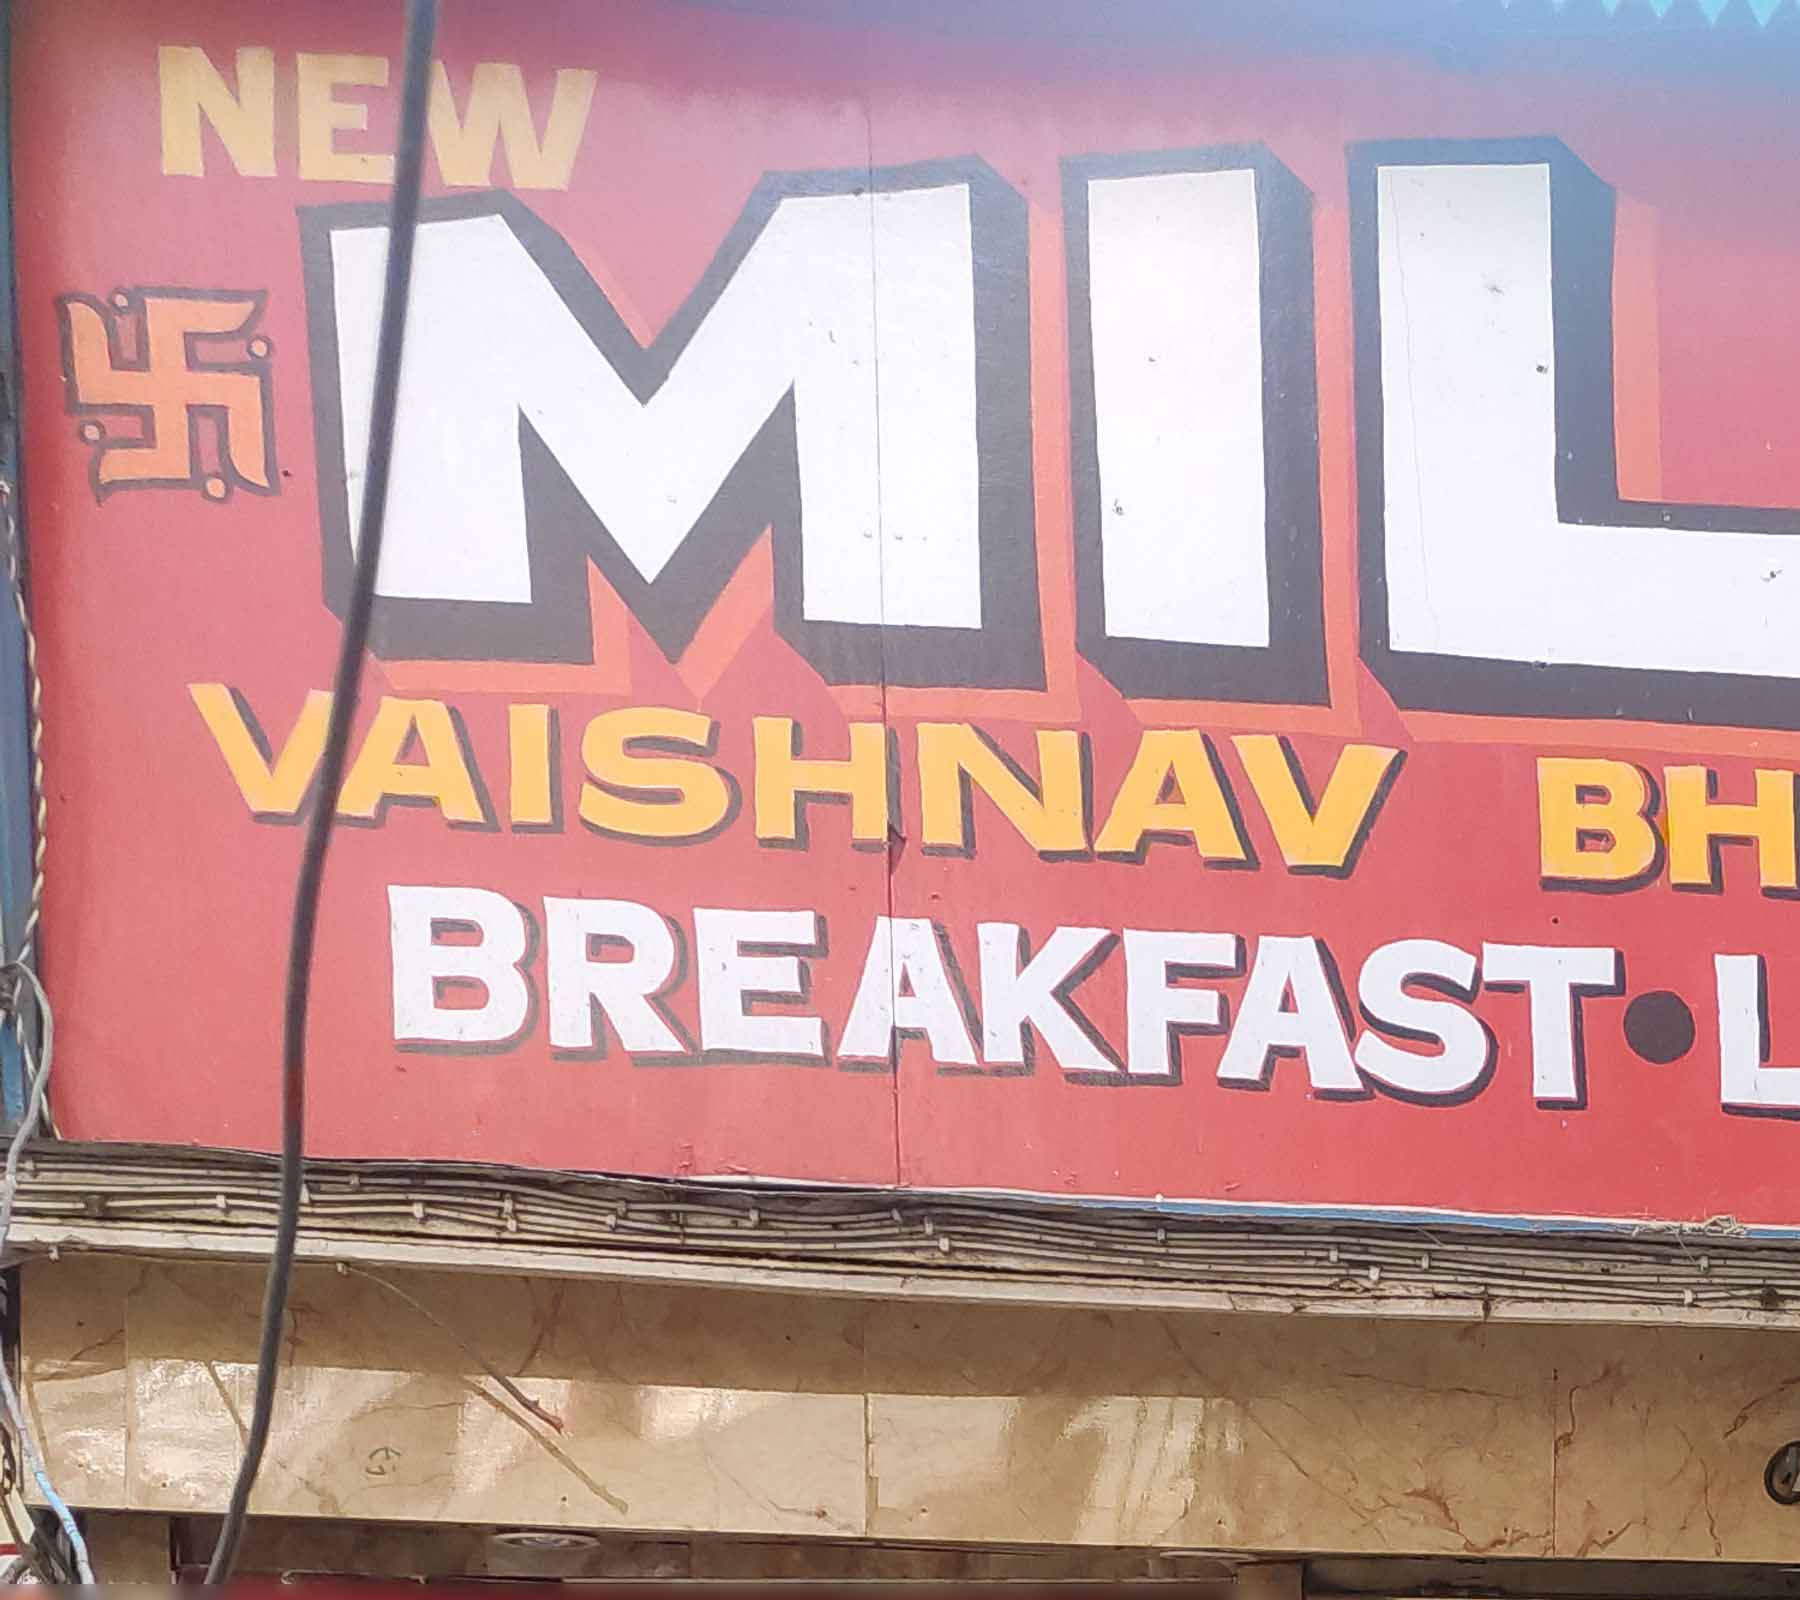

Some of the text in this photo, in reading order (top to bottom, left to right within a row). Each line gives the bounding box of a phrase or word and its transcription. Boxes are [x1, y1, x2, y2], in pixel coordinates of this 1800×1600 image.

[157, 46, 599, 190] NEW
[189, 681, 1406, 873] VAISHNAV
[388, 883, 1624, 1109] BREAKFAST
